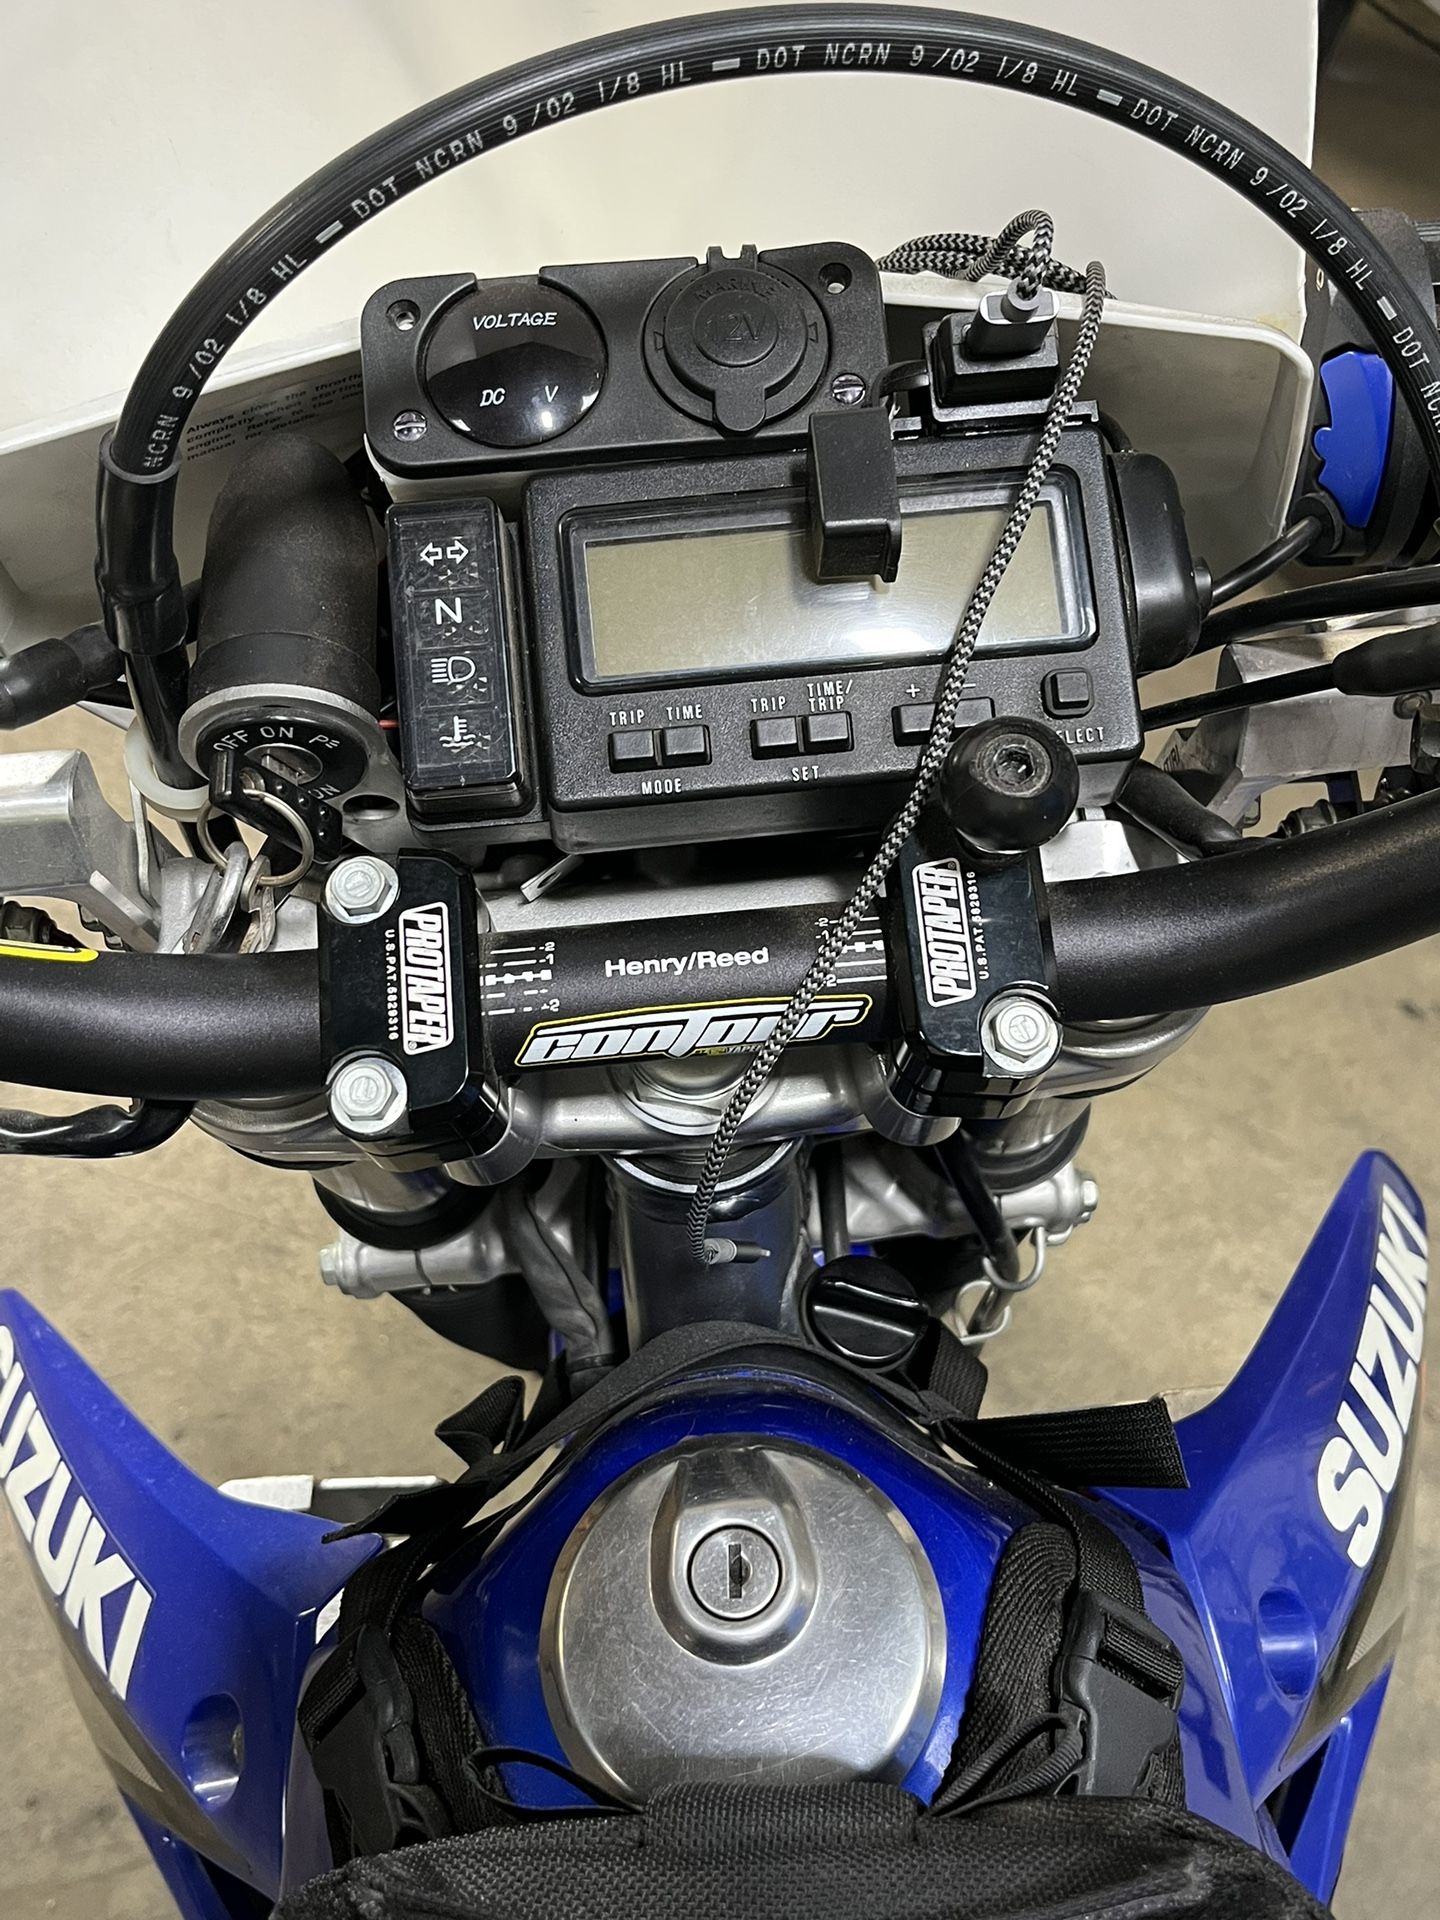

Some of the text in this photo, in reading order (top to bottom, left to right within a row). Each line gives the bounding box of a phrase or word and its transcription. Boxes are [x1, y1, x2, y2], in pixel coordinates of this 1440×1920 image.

[271, 254, 308, 281] HL
[351, 175, 401, 219] DOT
[415, 129, 484, 178] NCRN
[661, 61, 692, 87] HL
[756, 45, 805, 71] DOT
[824, 43, 891, 66] NCRN
[1051, 69, 1078, 97] HL
[1131, 98, 1179, 132] DOT
[1184, 124, 1245, 171] NCRN
[1346, 257, 1373, 291] HL
[1392, 326, 1430, 369] DOT
[473, 311, 558, 331] VOLTAGE
[479, 386, 559, 407] DC V
[187, 414, 235, 434] Always
[435, 597, 463, 625] N
[807, 679, 854, 697] TIME/
[609, 703, 703, 726] TRIP TIME
[750, 695, 846, 713] TRIP TRIP
[213, 729, 249, 751] OFF
[260, 726, 294, 739] ON
[1055, 726, 1104, 744] LECT
[792, 765, 820, 781] SET
[641, 778, 682, 795] MODE
[918, 865, 976, 998] PROTAPER
[605, 946, 770, 978] Henry/Reed
[402, 909, 449, 1047] PROTAPER
[1317, 1183, 1429, 1568] SUZUKI
